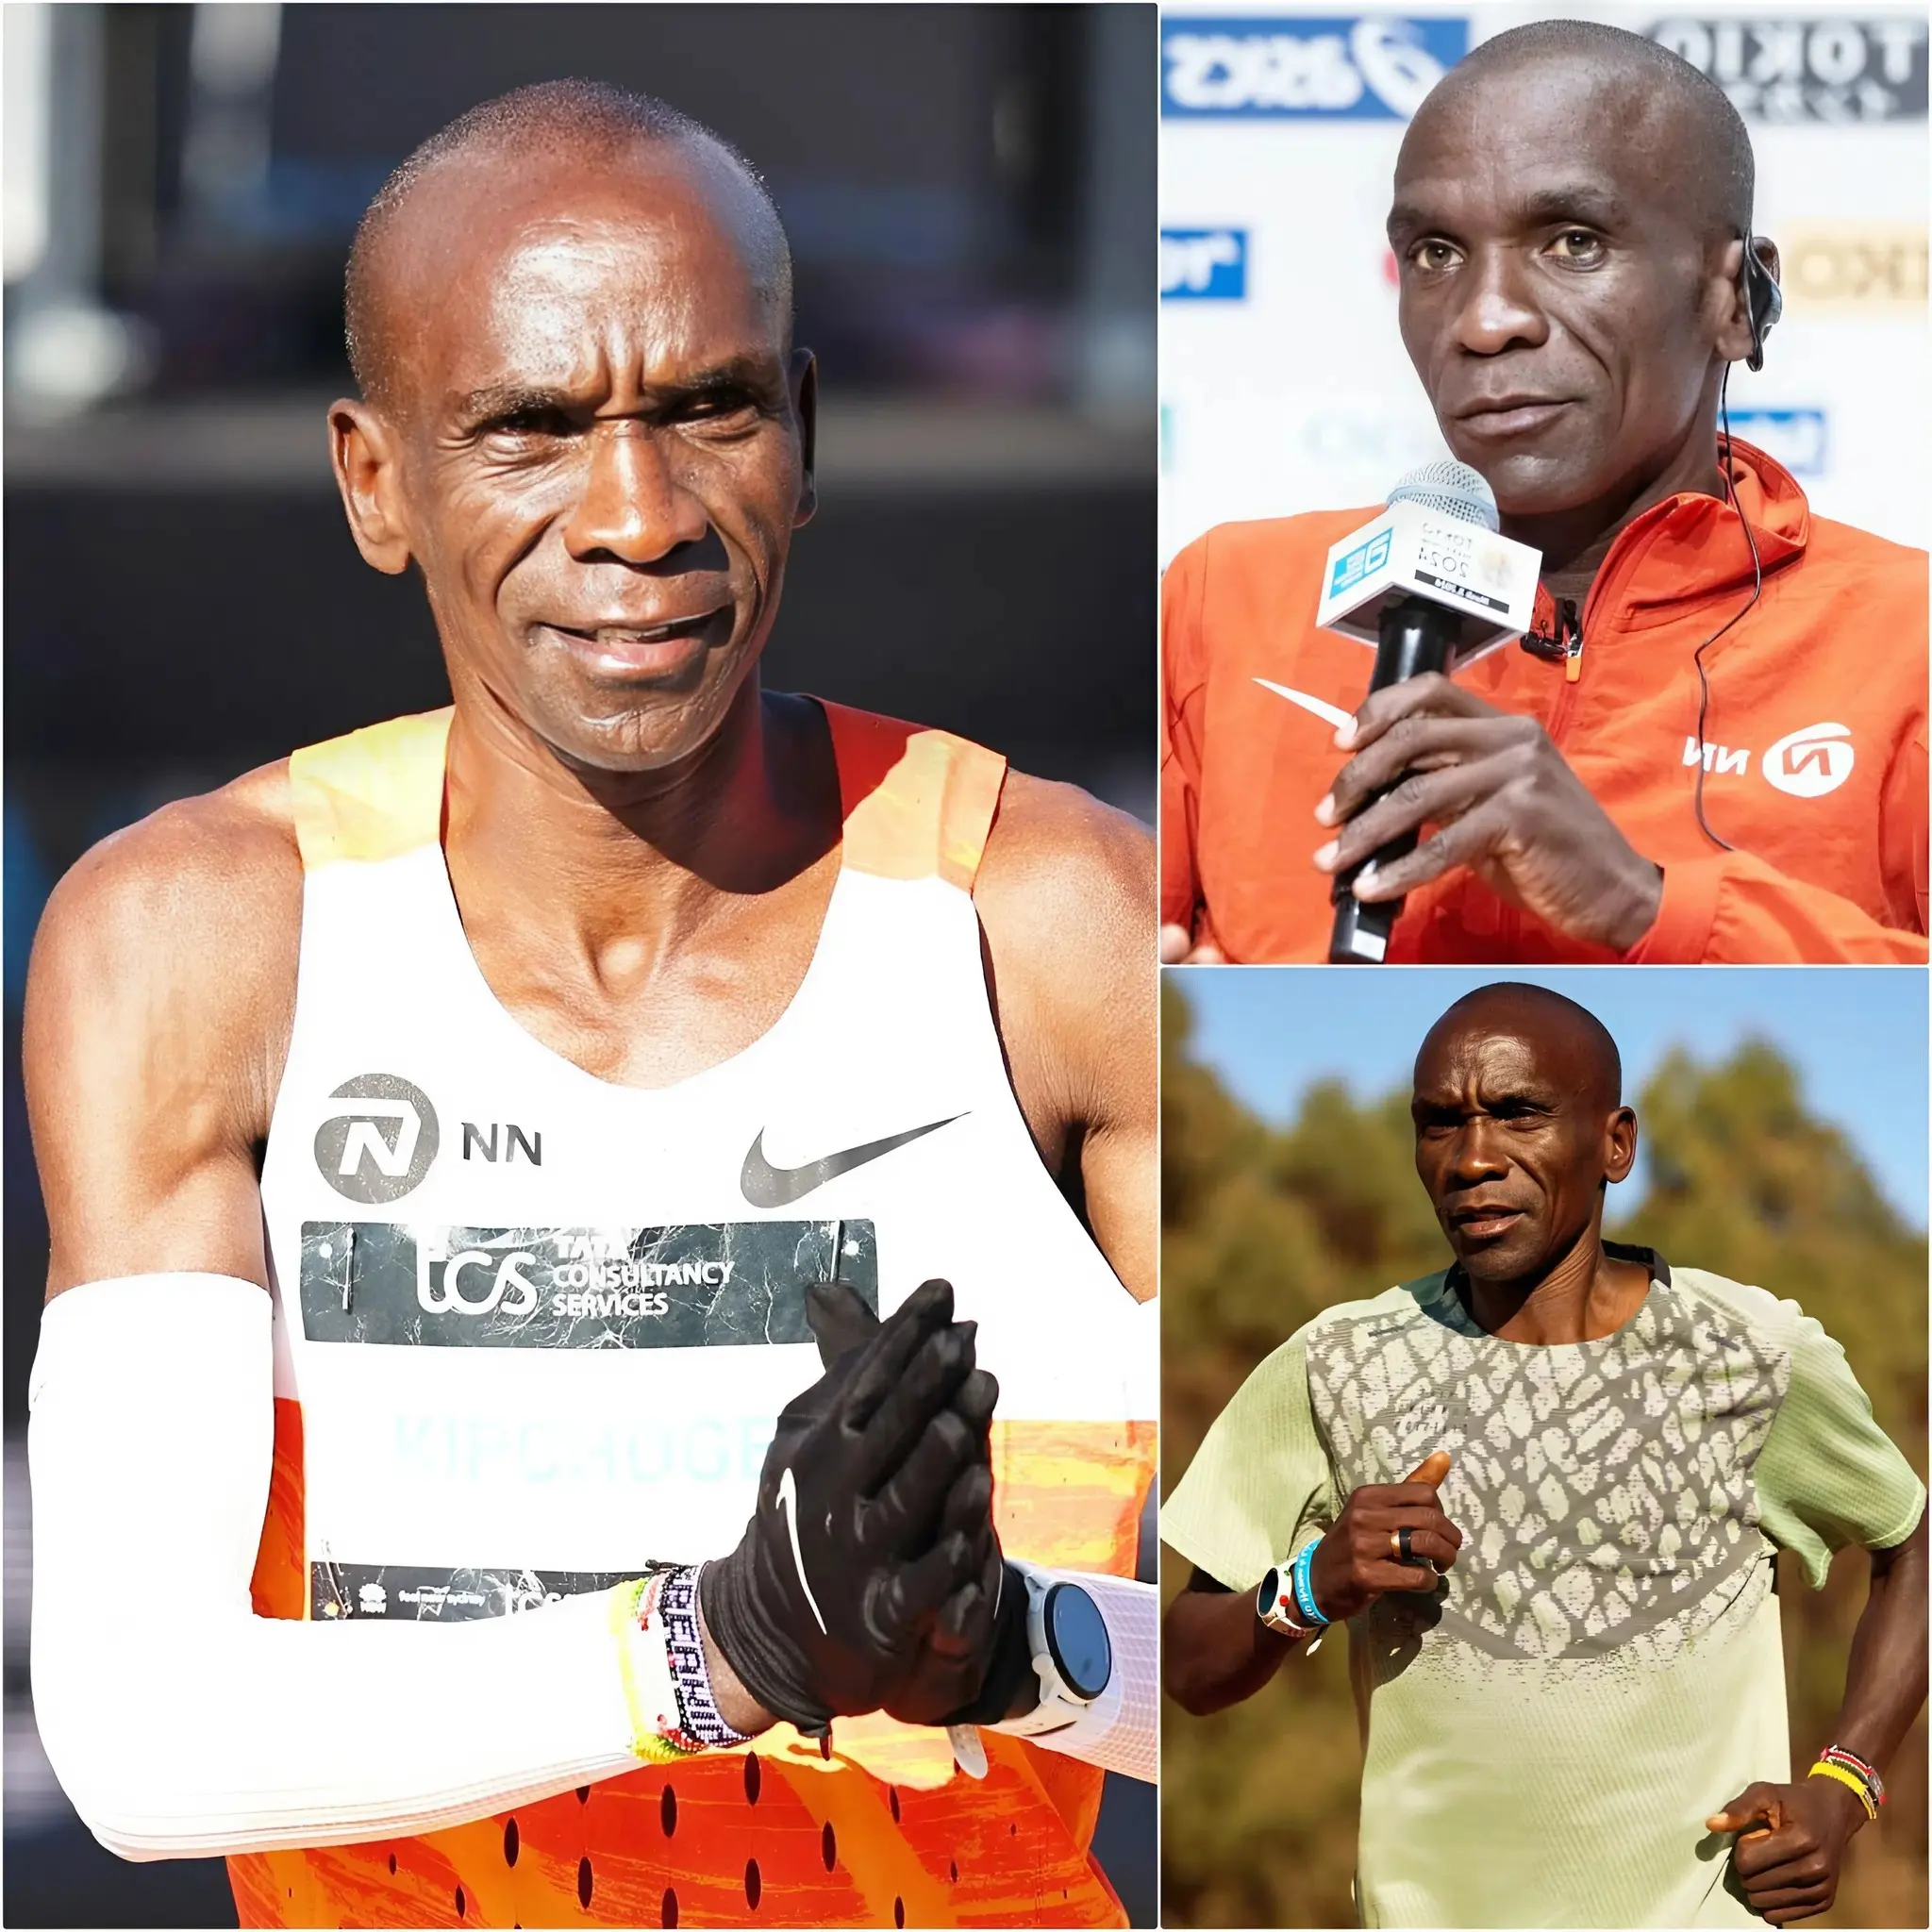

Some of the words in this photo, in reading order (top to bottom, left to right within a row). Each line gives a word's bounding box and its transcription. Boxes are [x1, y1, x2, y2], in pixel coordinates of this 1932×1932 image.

[461, 1122, 541, 1166] NN
[416, 1225, 537, 1315] tcs
[553, 1260, 735, 1289] CONSULTANCY
[553, 1292, 669, 1318] SERVICES
